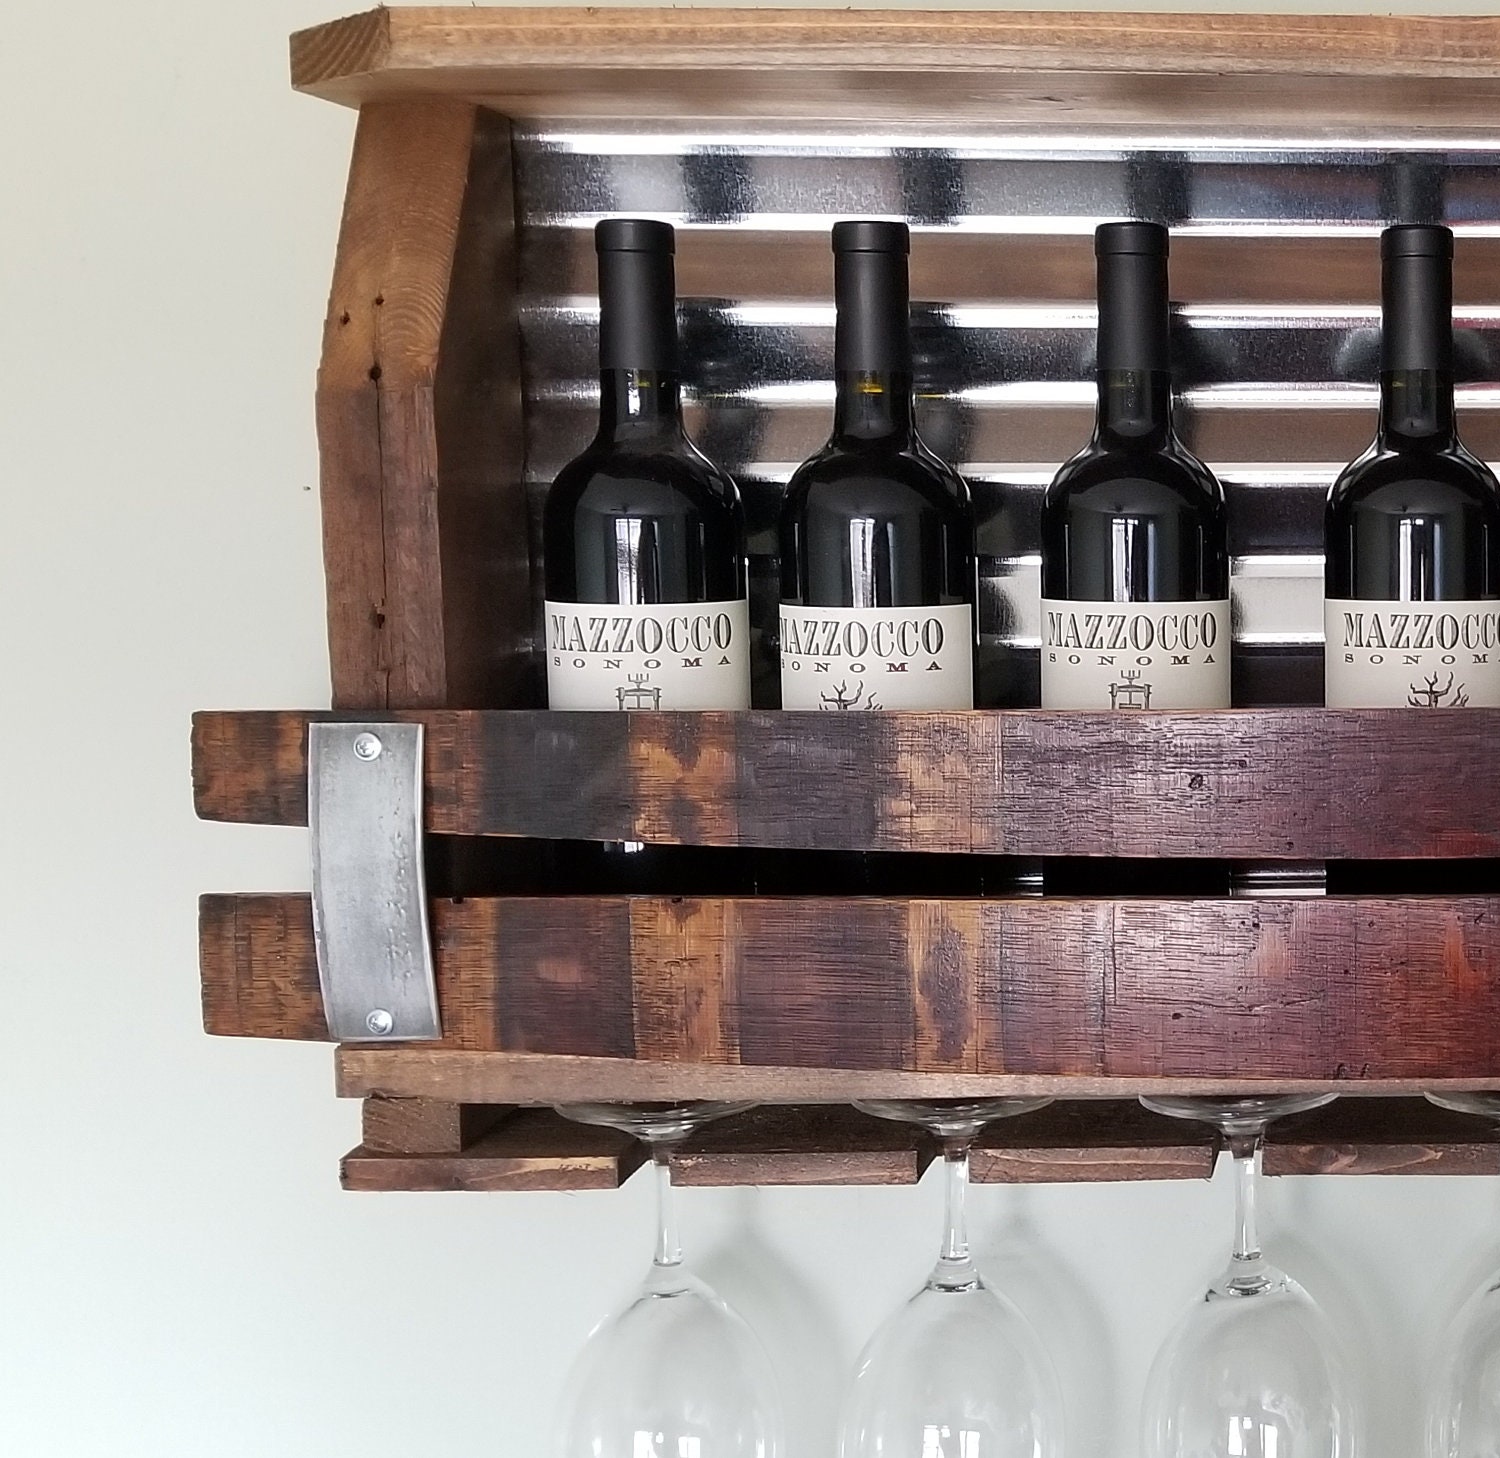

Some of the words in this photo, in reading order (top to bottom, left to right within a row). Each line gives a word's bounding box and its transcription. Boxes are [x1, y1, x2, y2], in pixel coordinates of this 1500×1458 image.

[551, 613, 732, 654] MAZZOCCO
[1048, 611, 1217, 651] MAZZOCCO
[554, 655, 732, 669] SONOMA
[1049, 652, 1216, 666] SONOMA
